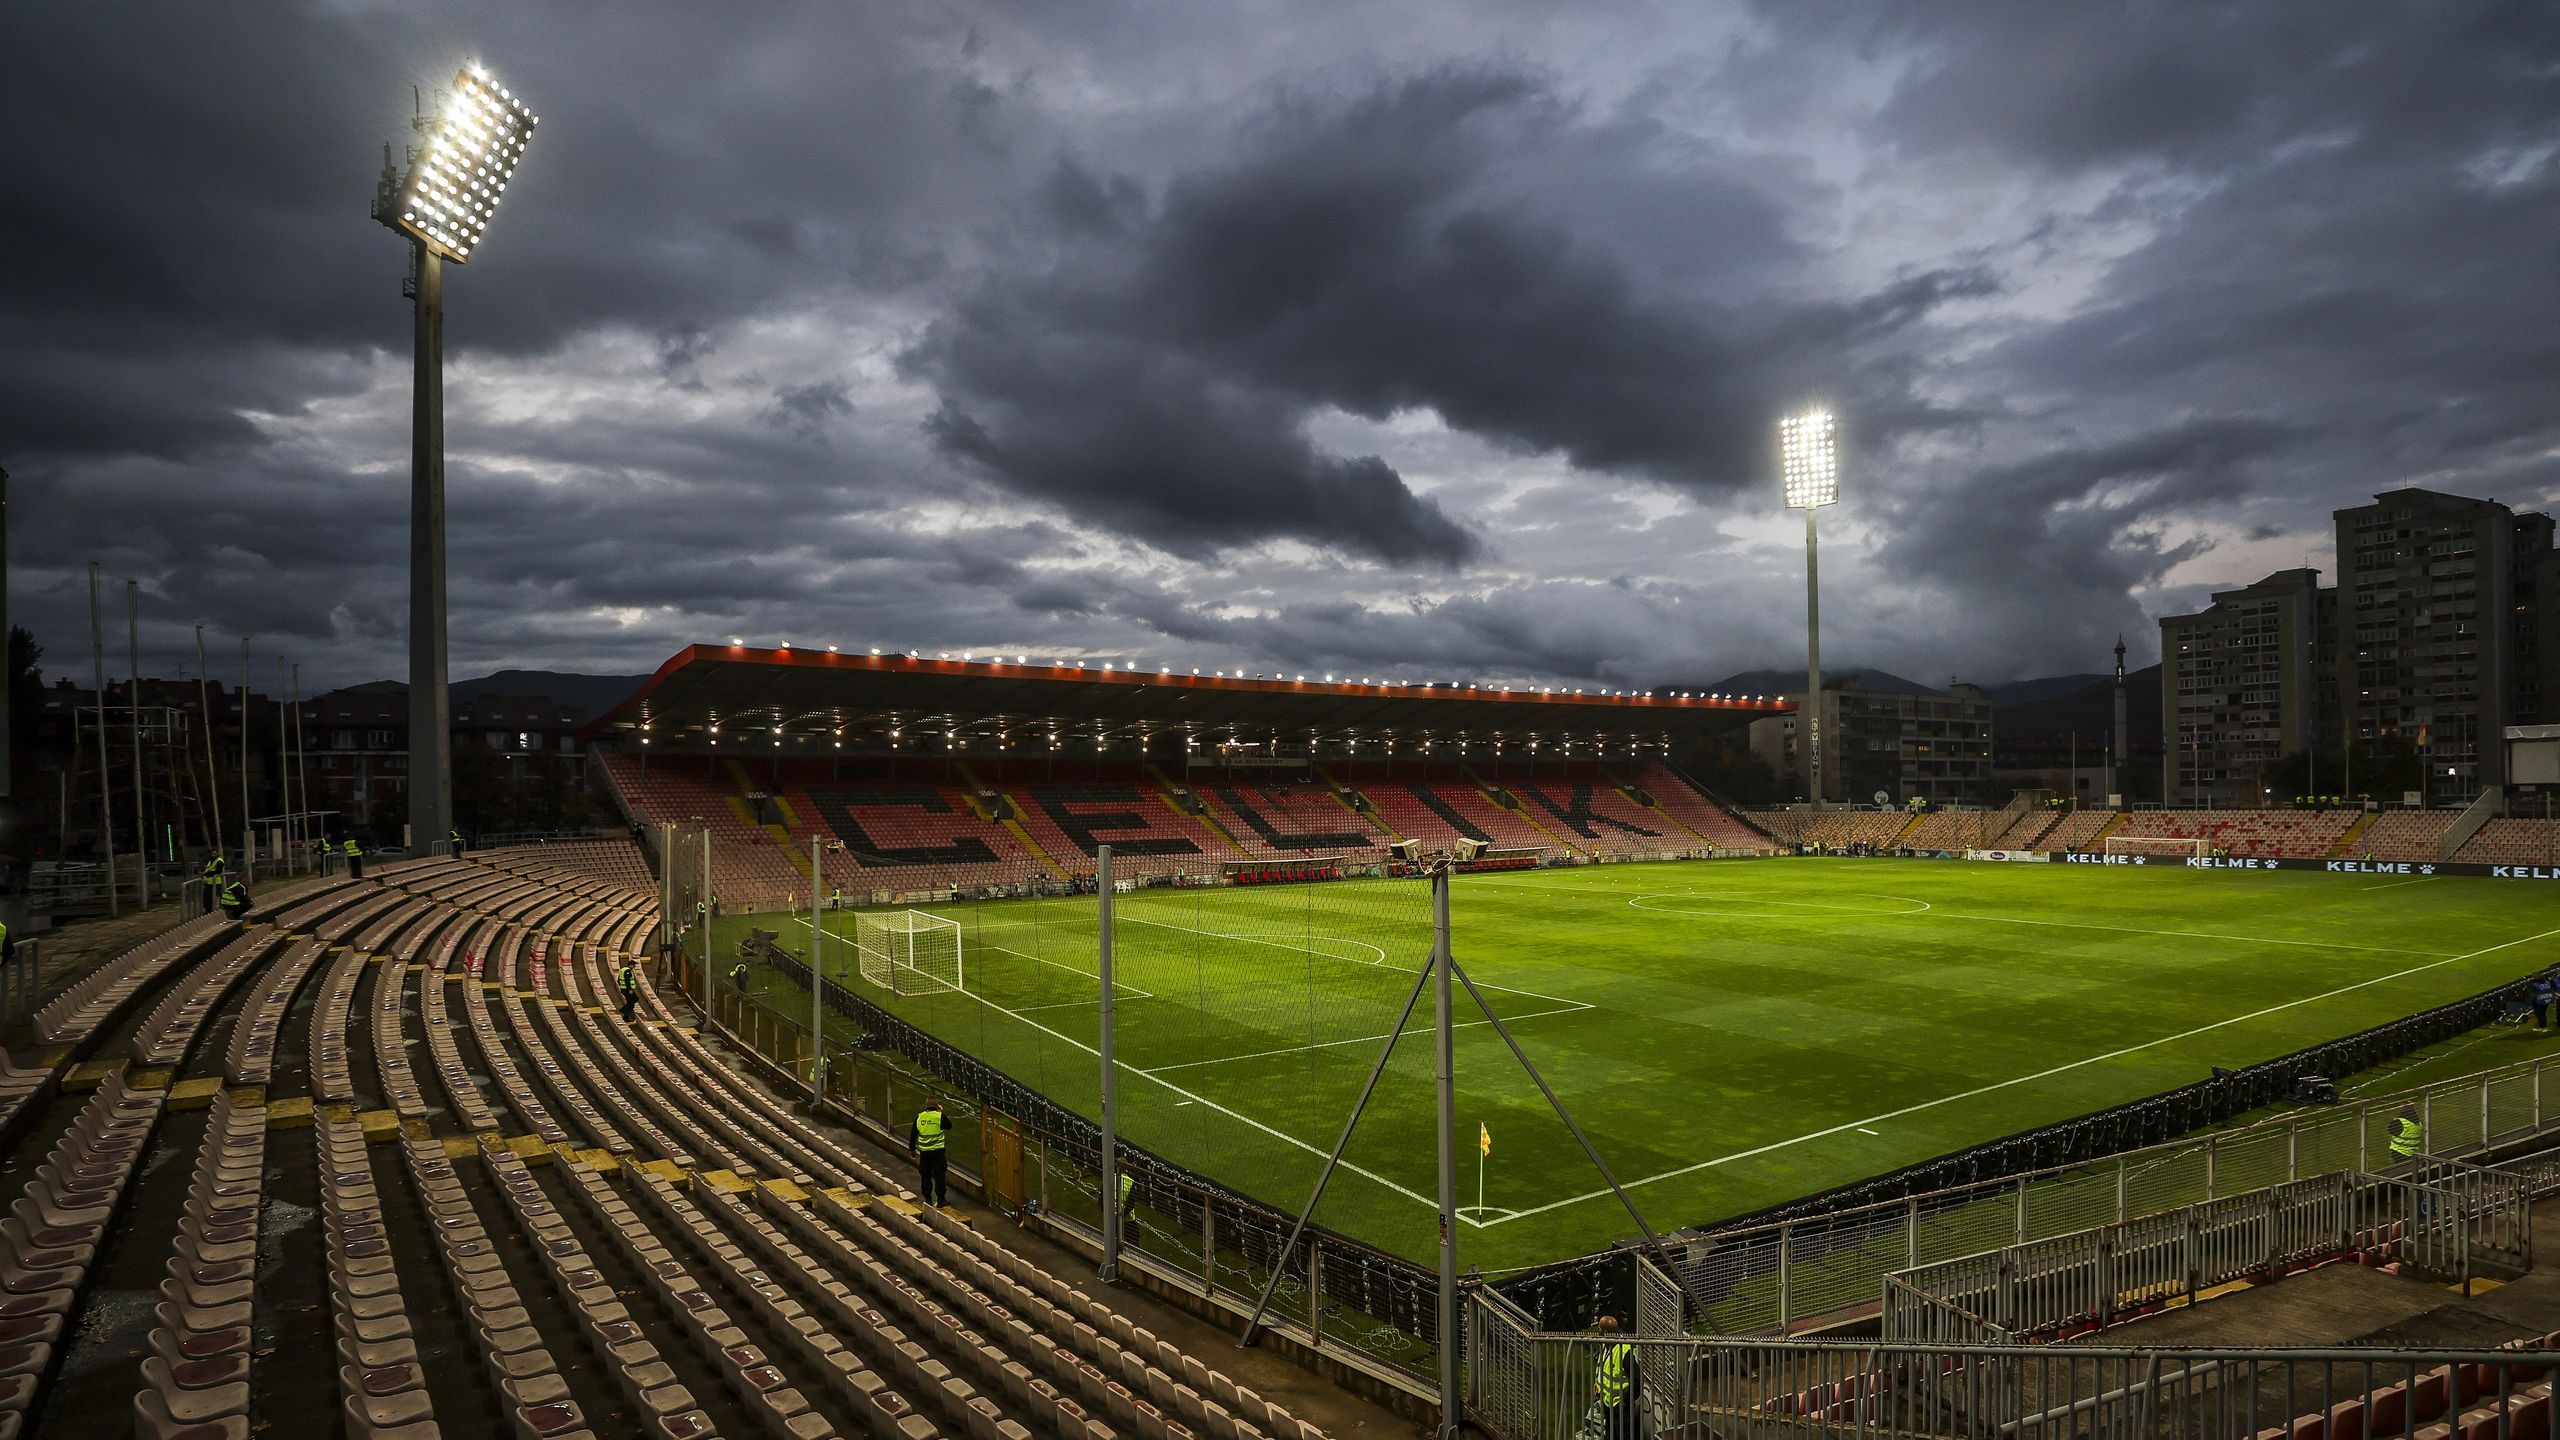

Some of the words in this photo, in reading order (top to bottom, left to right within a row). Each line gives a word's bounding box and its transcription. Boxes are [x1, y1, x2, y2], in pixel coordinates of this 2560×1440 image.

[2066, 853, 2129, 864] KELME
[2186, 857, 2258, 868] KELME
[2327, 861, 2412, 874] KELME
